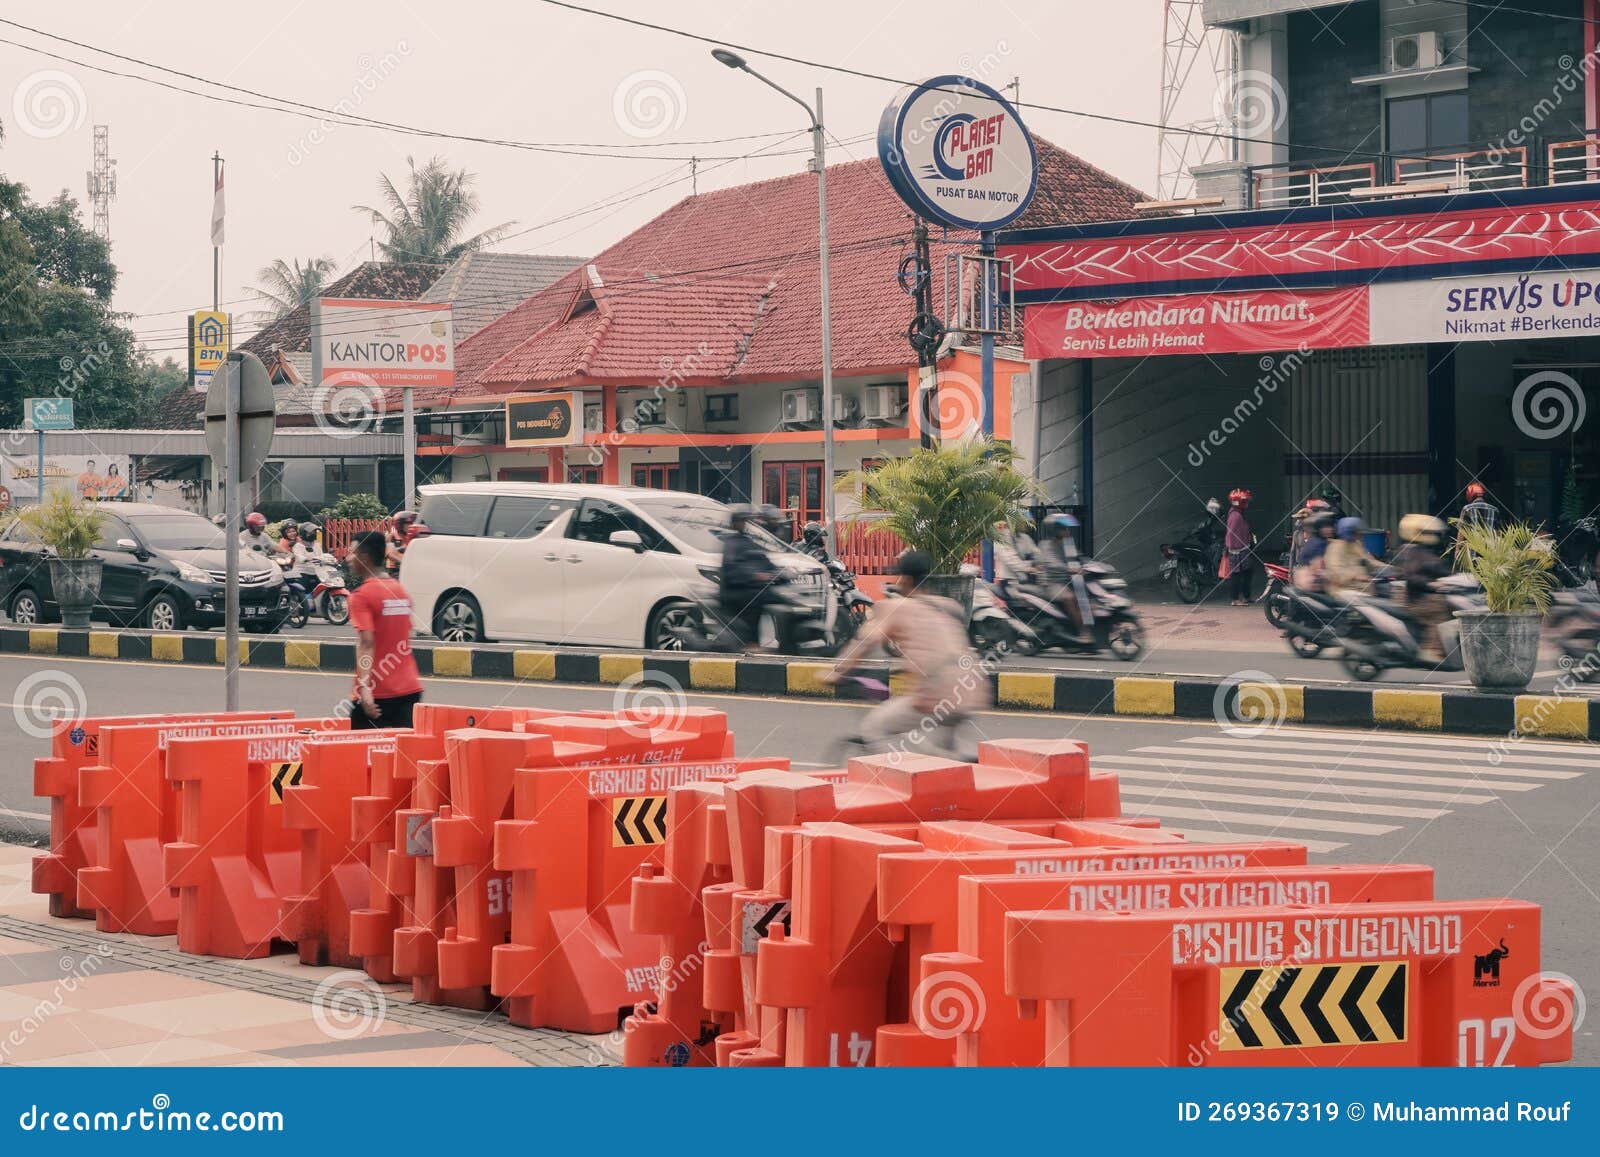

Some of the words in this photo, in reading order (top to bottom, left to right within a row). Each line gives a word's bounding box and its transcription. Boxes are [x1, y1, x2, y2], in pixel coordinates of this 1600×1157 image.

[951, 113, 1005, 158] PLANET
[966, 148, 993, 180] BAN
[936, 186, 964, 198] PUSAT
[967, 190, 986, 199] BAN
[988, 191, 1019, 203] MOTOR
[1446, 275, 1543, 314] SERVIS
[1065, 307, 1204, 330] Berkendara
[1210, 299, 1315, 325] Nikmat,
[1445, 319, 1505, 335] Nikmat
[200, 350, 224, 360] BTN
[1062, 335, 1105, 351] Servis
[1108, 332, 1149, 349] Lebih
[1152, 331, 1205, 348] Hemat
[588, 768, 647, 795] DISHUB
[1171, 919, 1284, 965] DISHUB
[1293, 914, 1462, 961] SITUBONDO
[1458, 1016, 1516, 1067] 02
